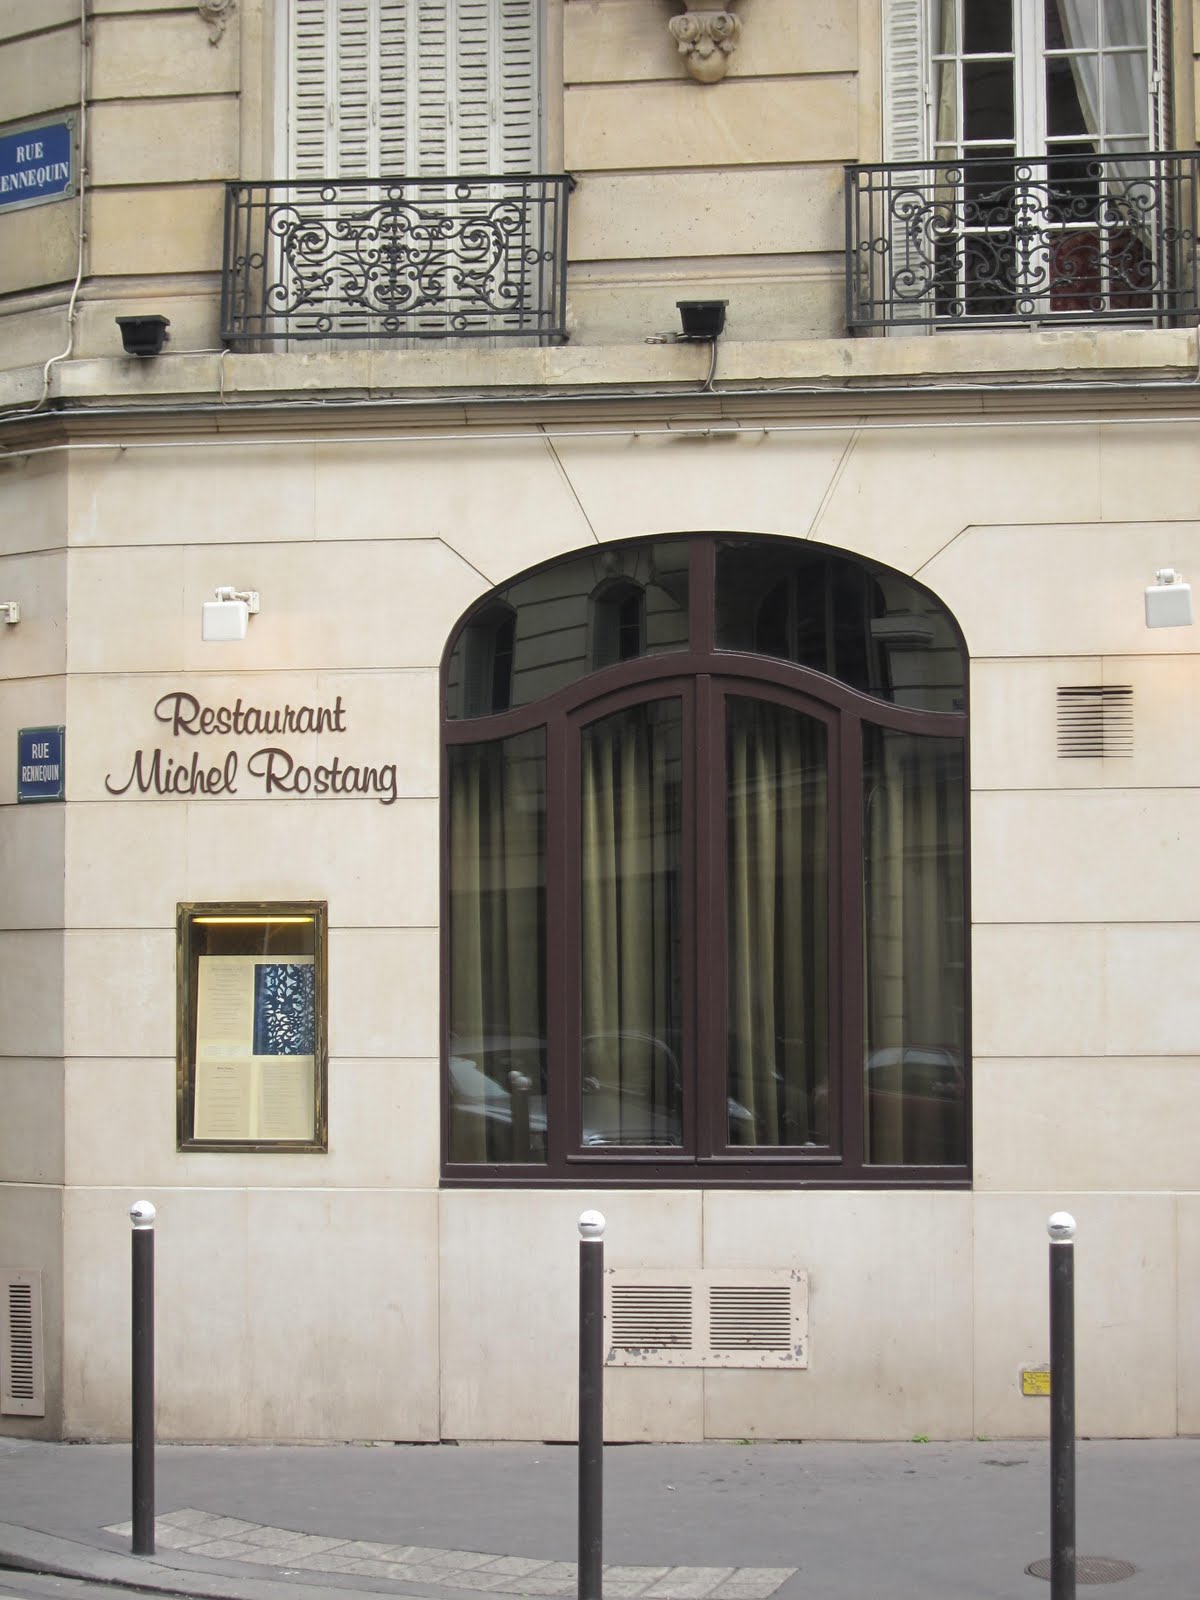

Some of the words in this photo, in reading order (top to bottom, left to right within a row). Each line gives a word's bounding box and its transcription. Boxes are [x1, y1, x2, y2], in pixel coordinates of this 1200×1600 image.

[16, 142, 43, 163] RUE
[0, 161, 69, 193] ENNEQUIN
[154, 691, 347, 736] Restaurant
[31, 742, 50, 760] RUE
[22, 764, 60, 783] RENNEQUIN
[105, 748, 238, 795] Michel
[247, 747, 397, 805] Rostang
